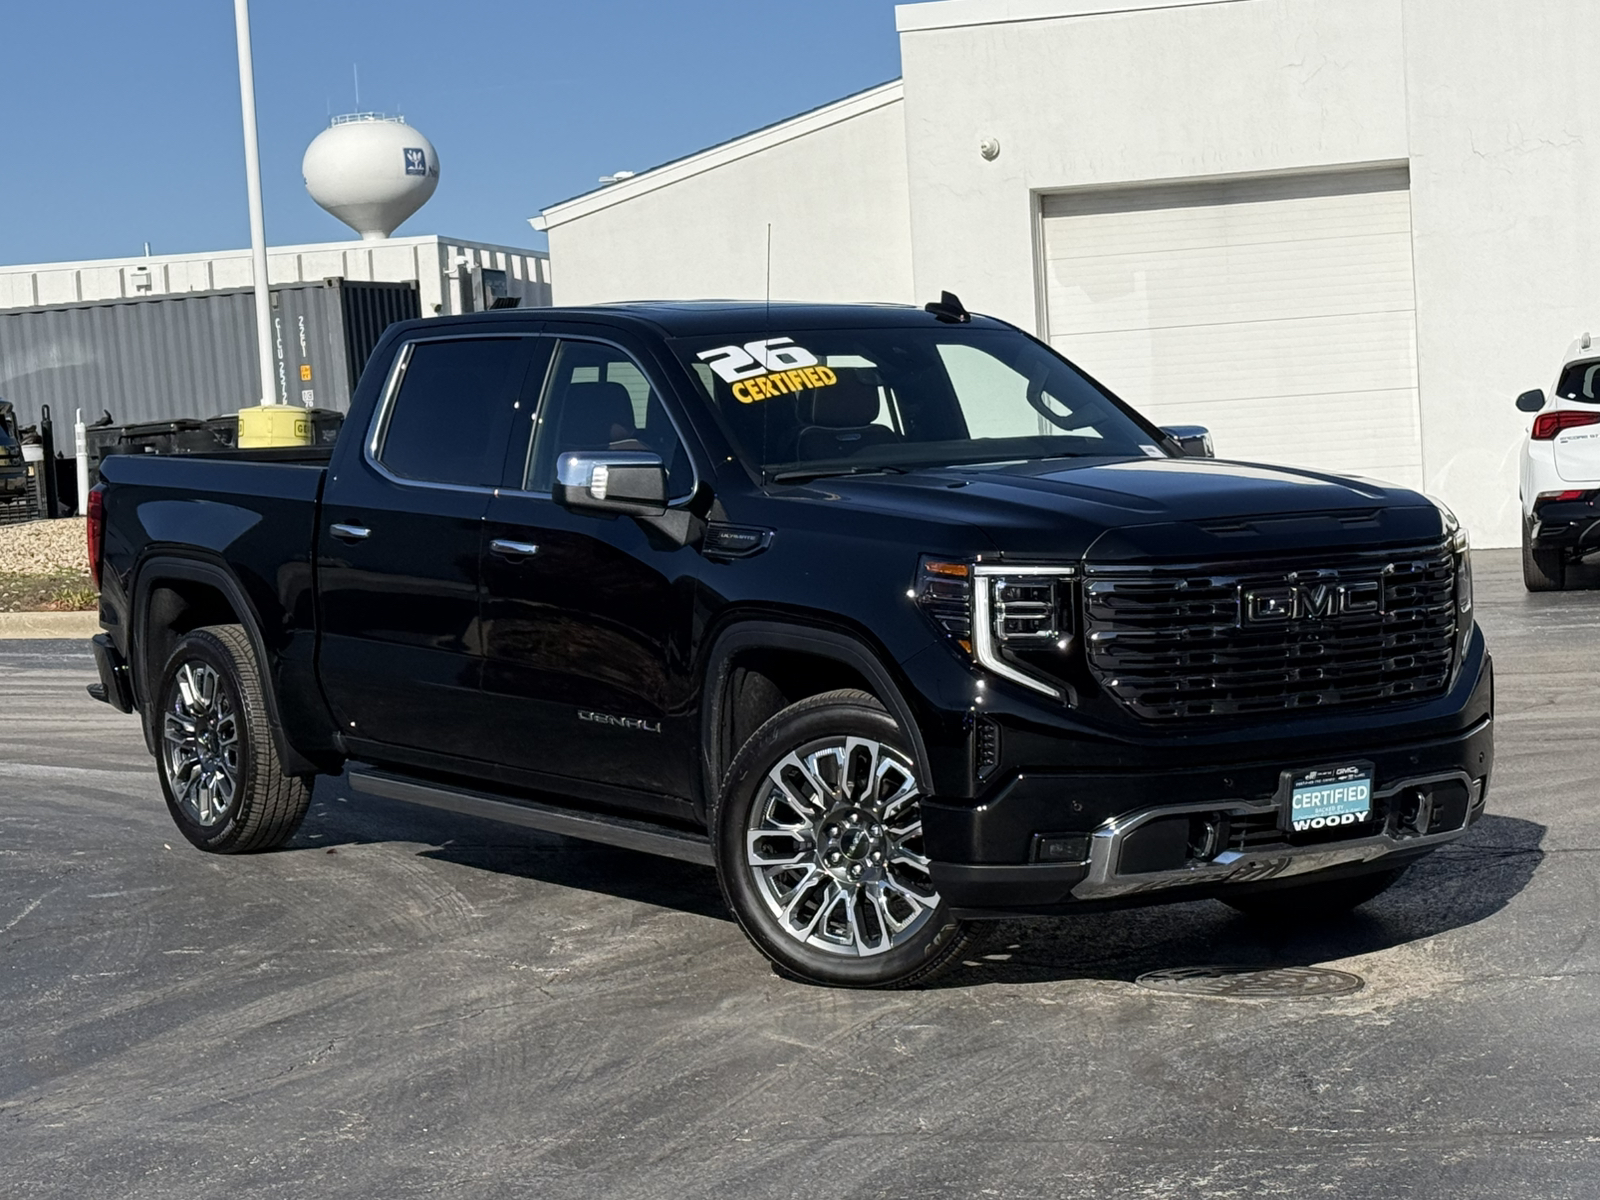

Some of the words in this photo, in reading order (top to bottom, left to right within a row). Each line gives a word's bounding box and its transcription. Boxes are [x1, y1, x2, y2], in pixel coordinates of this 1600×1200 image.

[298, 315, 306, 358] 22G1
[696, 336, 818, 383] 26
[731, 365, 837, 404] CERTIFIED
[1246, 581, 1378, 622] GMC
[577, 710, 661, 733] DENALI
[1292, 785, 1368, 809] CERTIFIED
[1315, 805, 1336, 813] BACKED
[1293, 811, 1369, 832] WOODY
